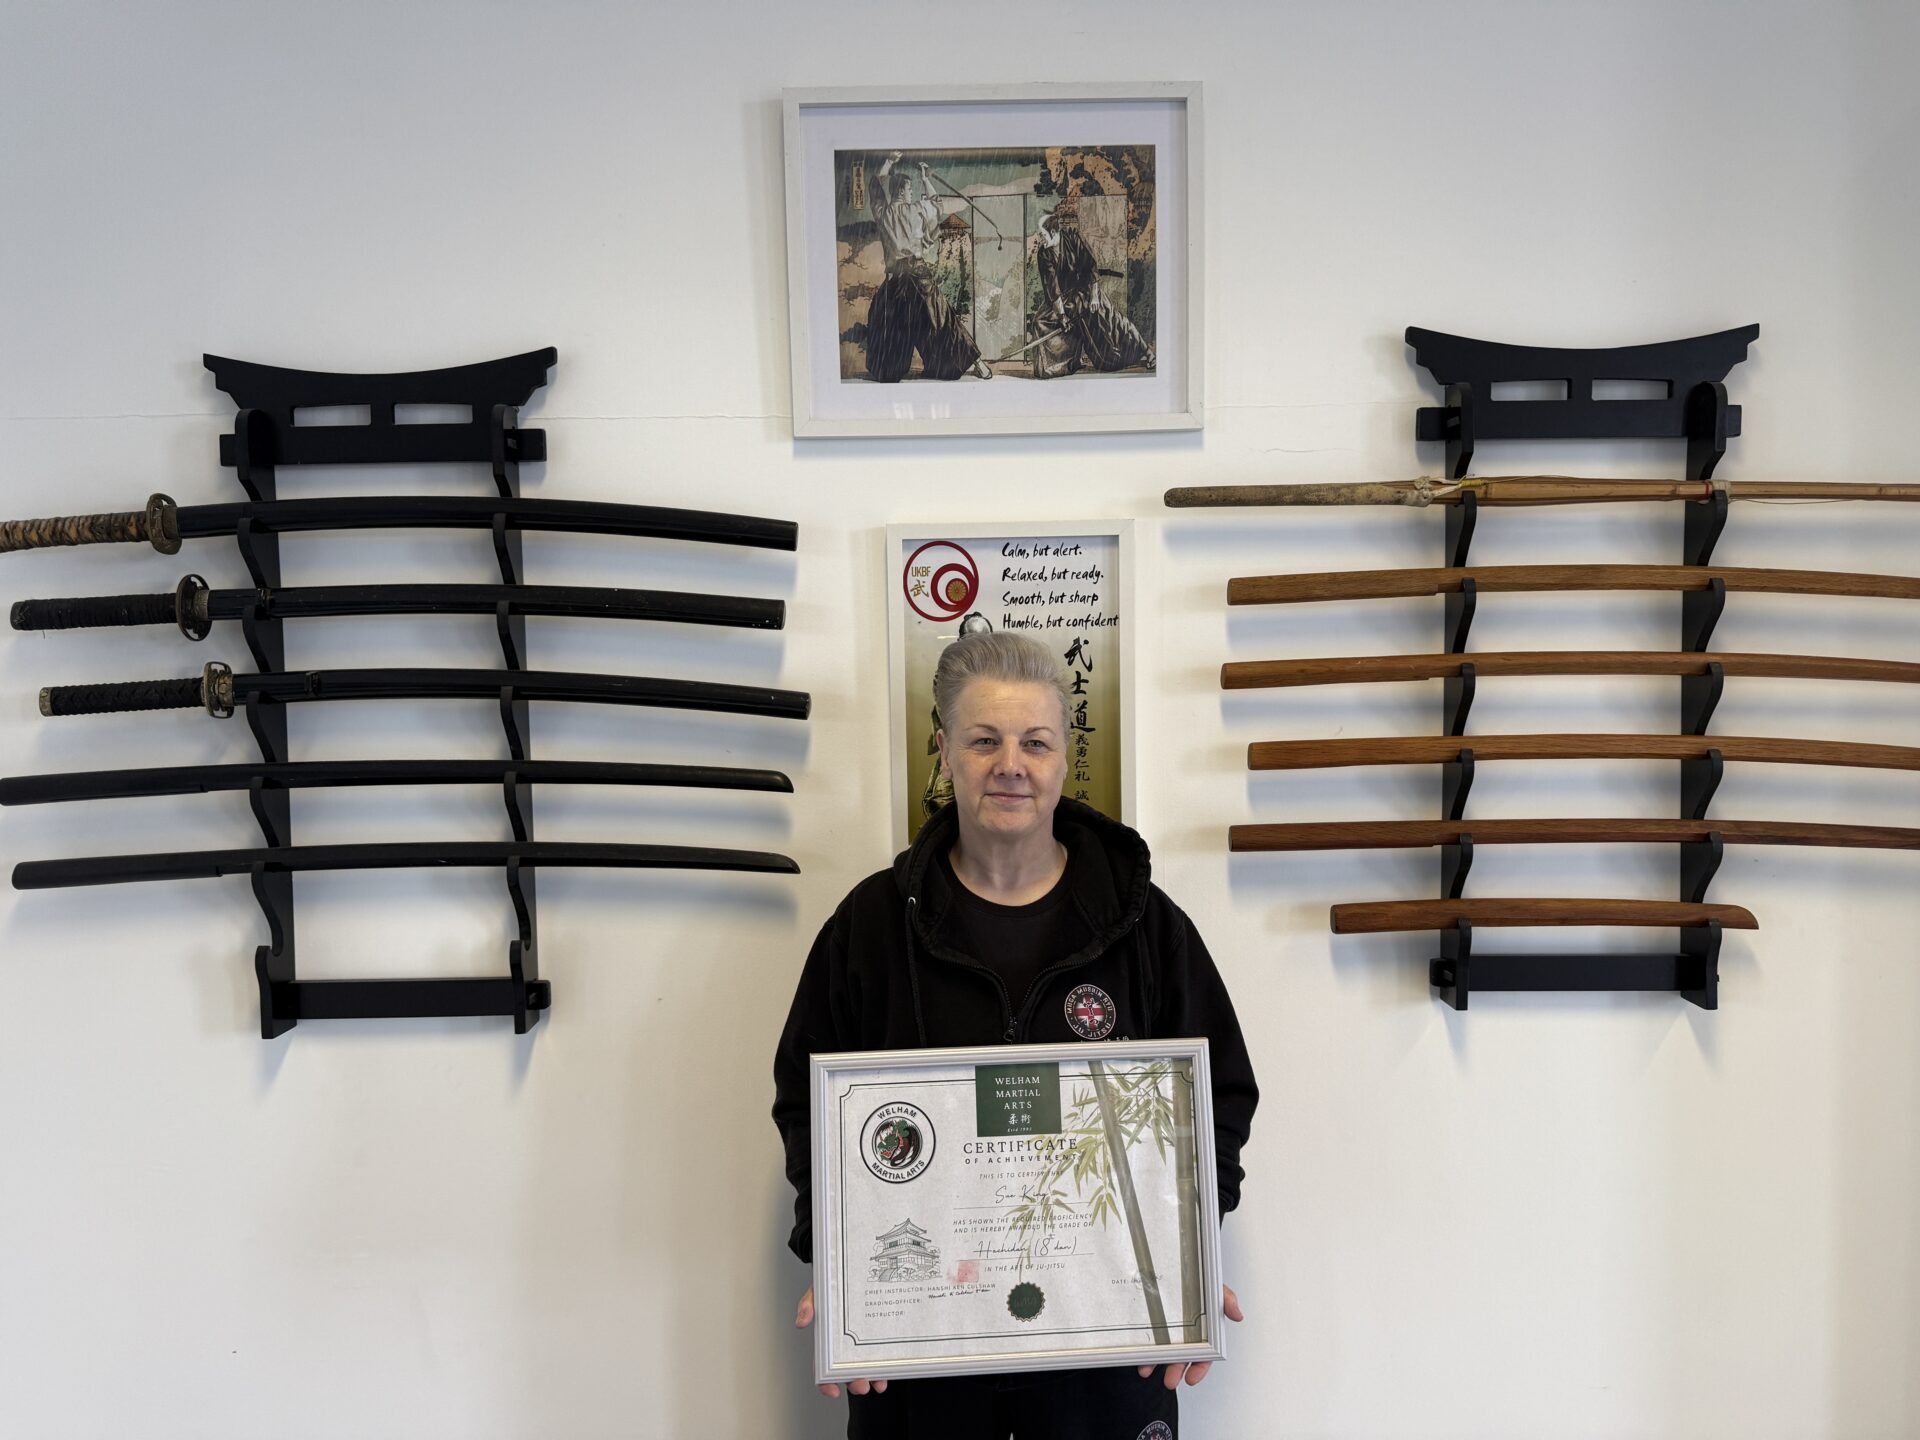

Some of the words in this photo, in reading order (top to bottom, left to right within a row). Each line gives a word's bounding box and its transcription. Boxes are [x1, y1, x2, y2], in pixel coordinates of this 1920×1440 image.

[1002, 542, 1029, 559] Calm,
[1033, 543, 1051, 557] but
[1053, 542, 1082, 557] alert.
[911, 566, 931, 577] UKBF
[1002, 565, 1047, 582] Relaxed,
[1051, 567, 1069, 581] but
[1071, 564, 1104, 584] ready.
[910, 579, 929, 597] 武
[1002, 591, 1045, 606] Smooth,
[1049, 590, 1067, 605] but
[1068, 590, 1099, 606] sharp
[1003, 612, 1043, 630] Humble,
[1047, 615, 1064, 628] but
[1066, 612, 1119, 630] confident
[995, 1076, 1040, 1085] WELHAM
[996, 1089, 1040, 1098] MARTIAL
[877, 1106, 917, 1119] WELHAM
[1004, 1101, 1032, 1110] ARTS
[963, 1138, 1078, 1154] CERTIFICATE
[988, 1154, 1078, 1164] ACHIEVEMENT
[872, 1162, 906, 1180] MARTIAL
[906, 1160, 925, 1179] ARTS
